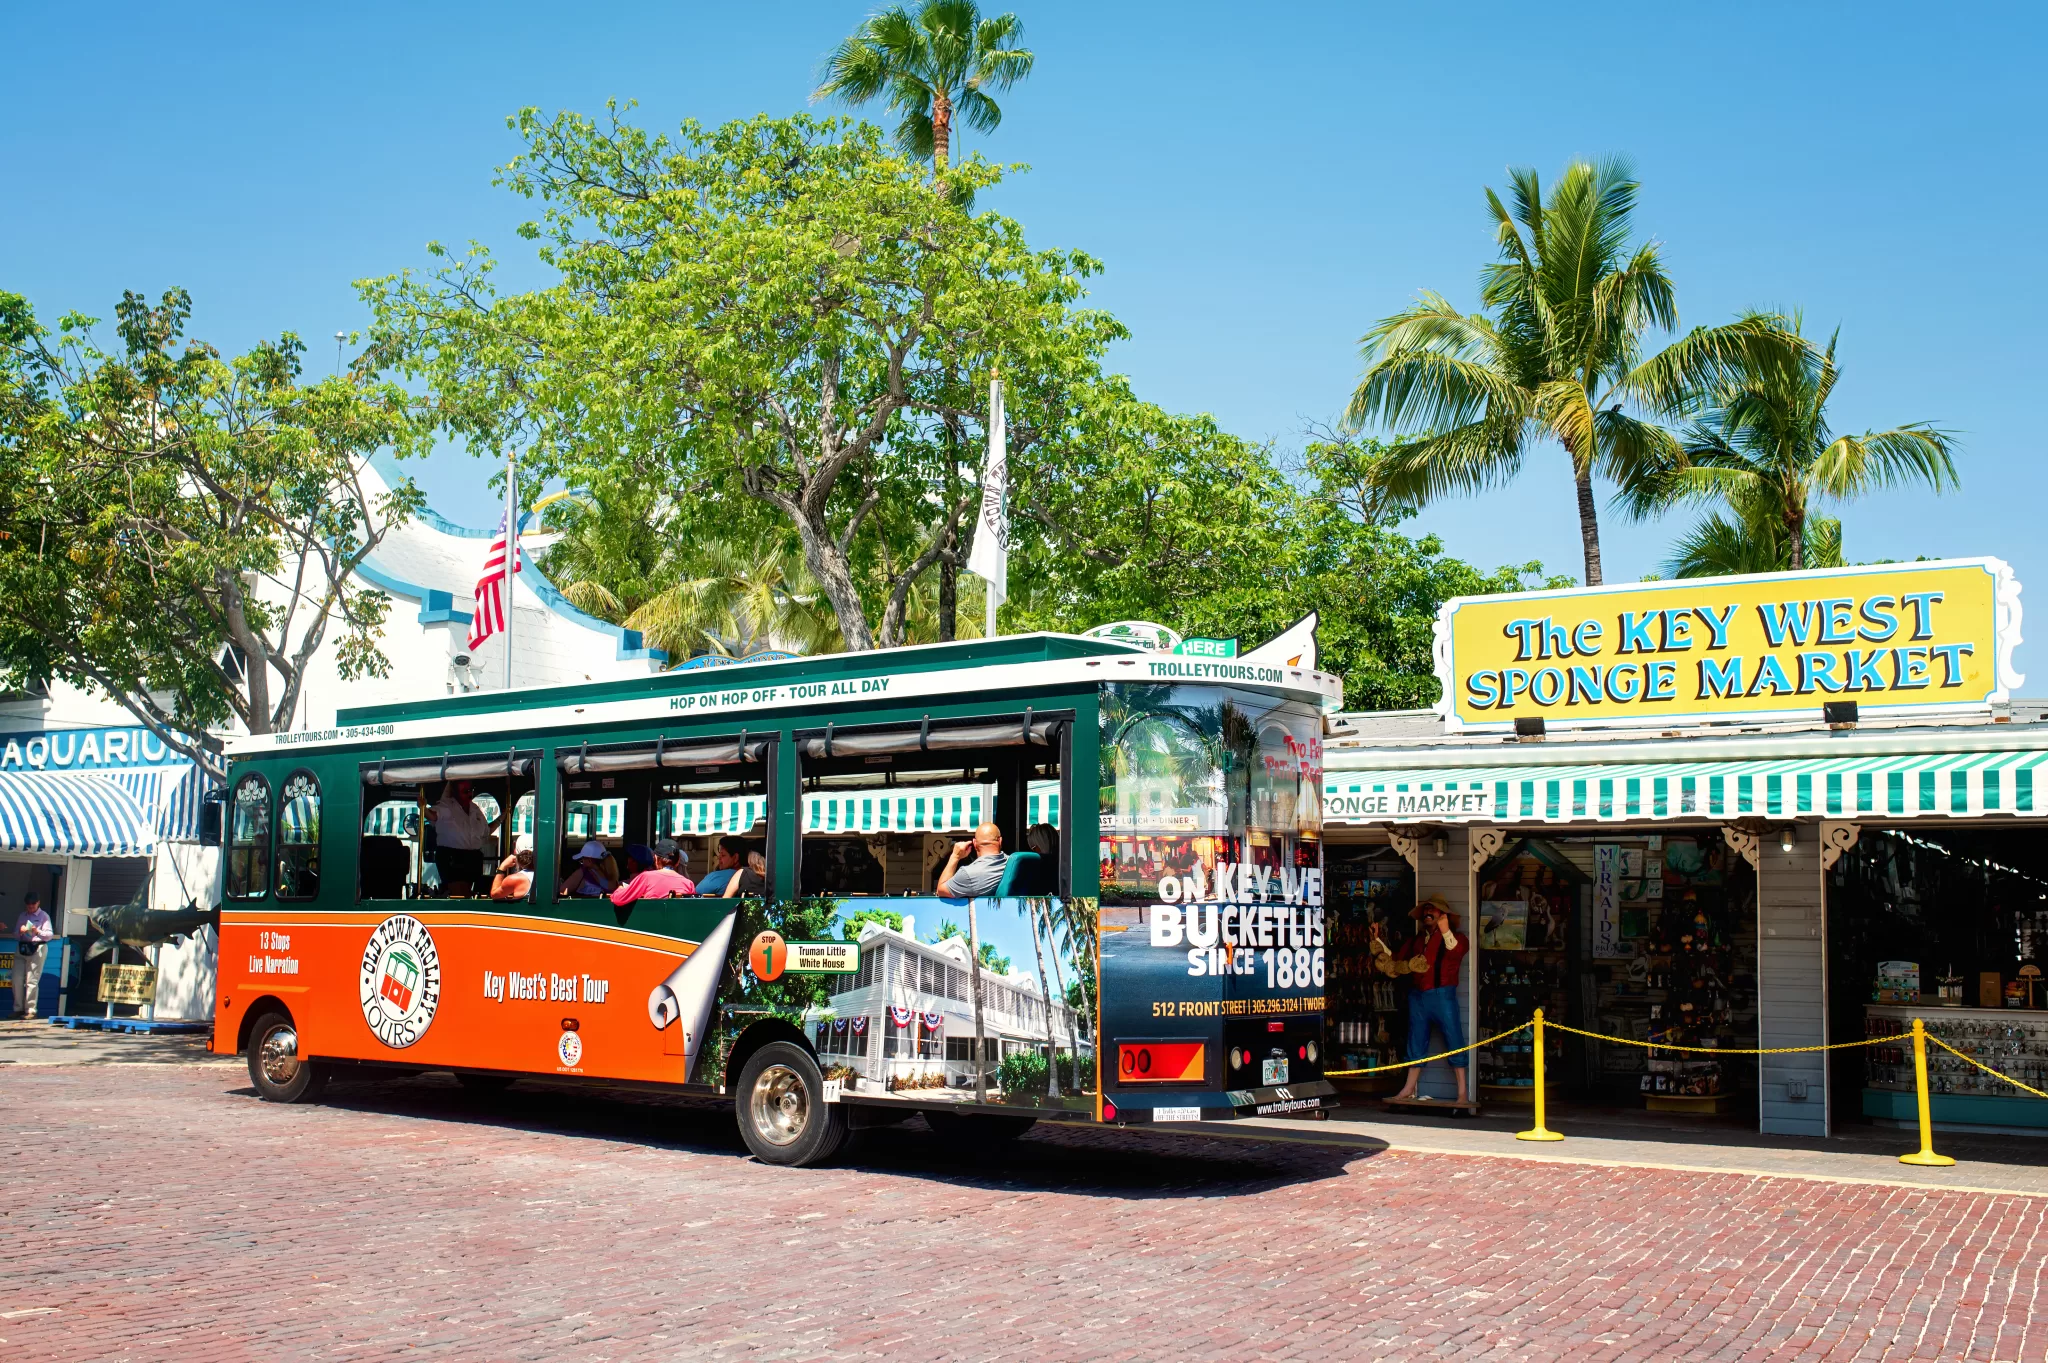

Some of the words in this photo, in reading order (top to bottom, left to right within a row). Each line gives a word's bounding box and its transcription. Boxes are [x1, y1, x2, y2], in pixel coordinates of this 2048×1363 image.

[1504, 615, 1604, 662] The
[1616, 604, 1739, 653] KEY
[1758, 591, 1945, 648] WEST
[1182, 640, 1226, 656] HERE
[1148, 662, 1283, 683] TROLLEYTOURS.COM
[1467, 660, 1678, 710] SPONGE
[1695, 643, 1974, 701] MARKET
[670, 697, 696, 710] HOP
[699, 695, 717, 707] ON
[721, 692, 748, 706] HOP
[752, 689, 777, 703] OFF
[789, 684, 827, 699] TOUR
[831, 681, 857, 696] ALL
[862, 678, 890, 693] DAY
[275, 730, 339, 745] TROLLEYTOURS.COM
[345, 725, 394, 739] 305-434-4900
[1397, 794, 1487, 813] MARKET
[1160, 817, 1189, 825] DINNER
[1158, 876, 1207, 904] ON
[1217, 862, 1272, 904] KEY
[1600, 848, 1612, 944] MERMAIDS
[260, 931, 269, 950] 13
[271, 931, 291, 952] Stops
[761, 936, 776, 944] STOP
[763, 945, 772, 974] 1
[799, 946, 825, 956] Truman
[826, 946, 846, 956] Little
[249, 955, 263, 973] Live
[264, 955, 299, 974] Narration
[363, 938, 382, 974] OLD
[379, 918, 415, 945] TOWN
[414, 927, 439, 1018] TROLLEY
[799, 958, 820, 968] White
[822, 959, 845, 969] House
[1187, 948, 1255, 976] SINCE
[1263, 948, 1324, 989] 1886
[484, 971, 505, 1003] Key
[509, 971, 547, 1001] West's
[550, 973, 578, 1002] Best
[582, 974, 609, 1004] Tour
[363, 988, 416, 1046] TOURS
[1152, 1001, 1176, 1017] 512
[1179, 1001, 1221, 1017] FRONT
[1221, 999, 1247, 1015] STREET
[1252, 997, 1299, 1014] 305.296.3124
[1256, 1098, 1320, 1115] www.trolleytours.com
